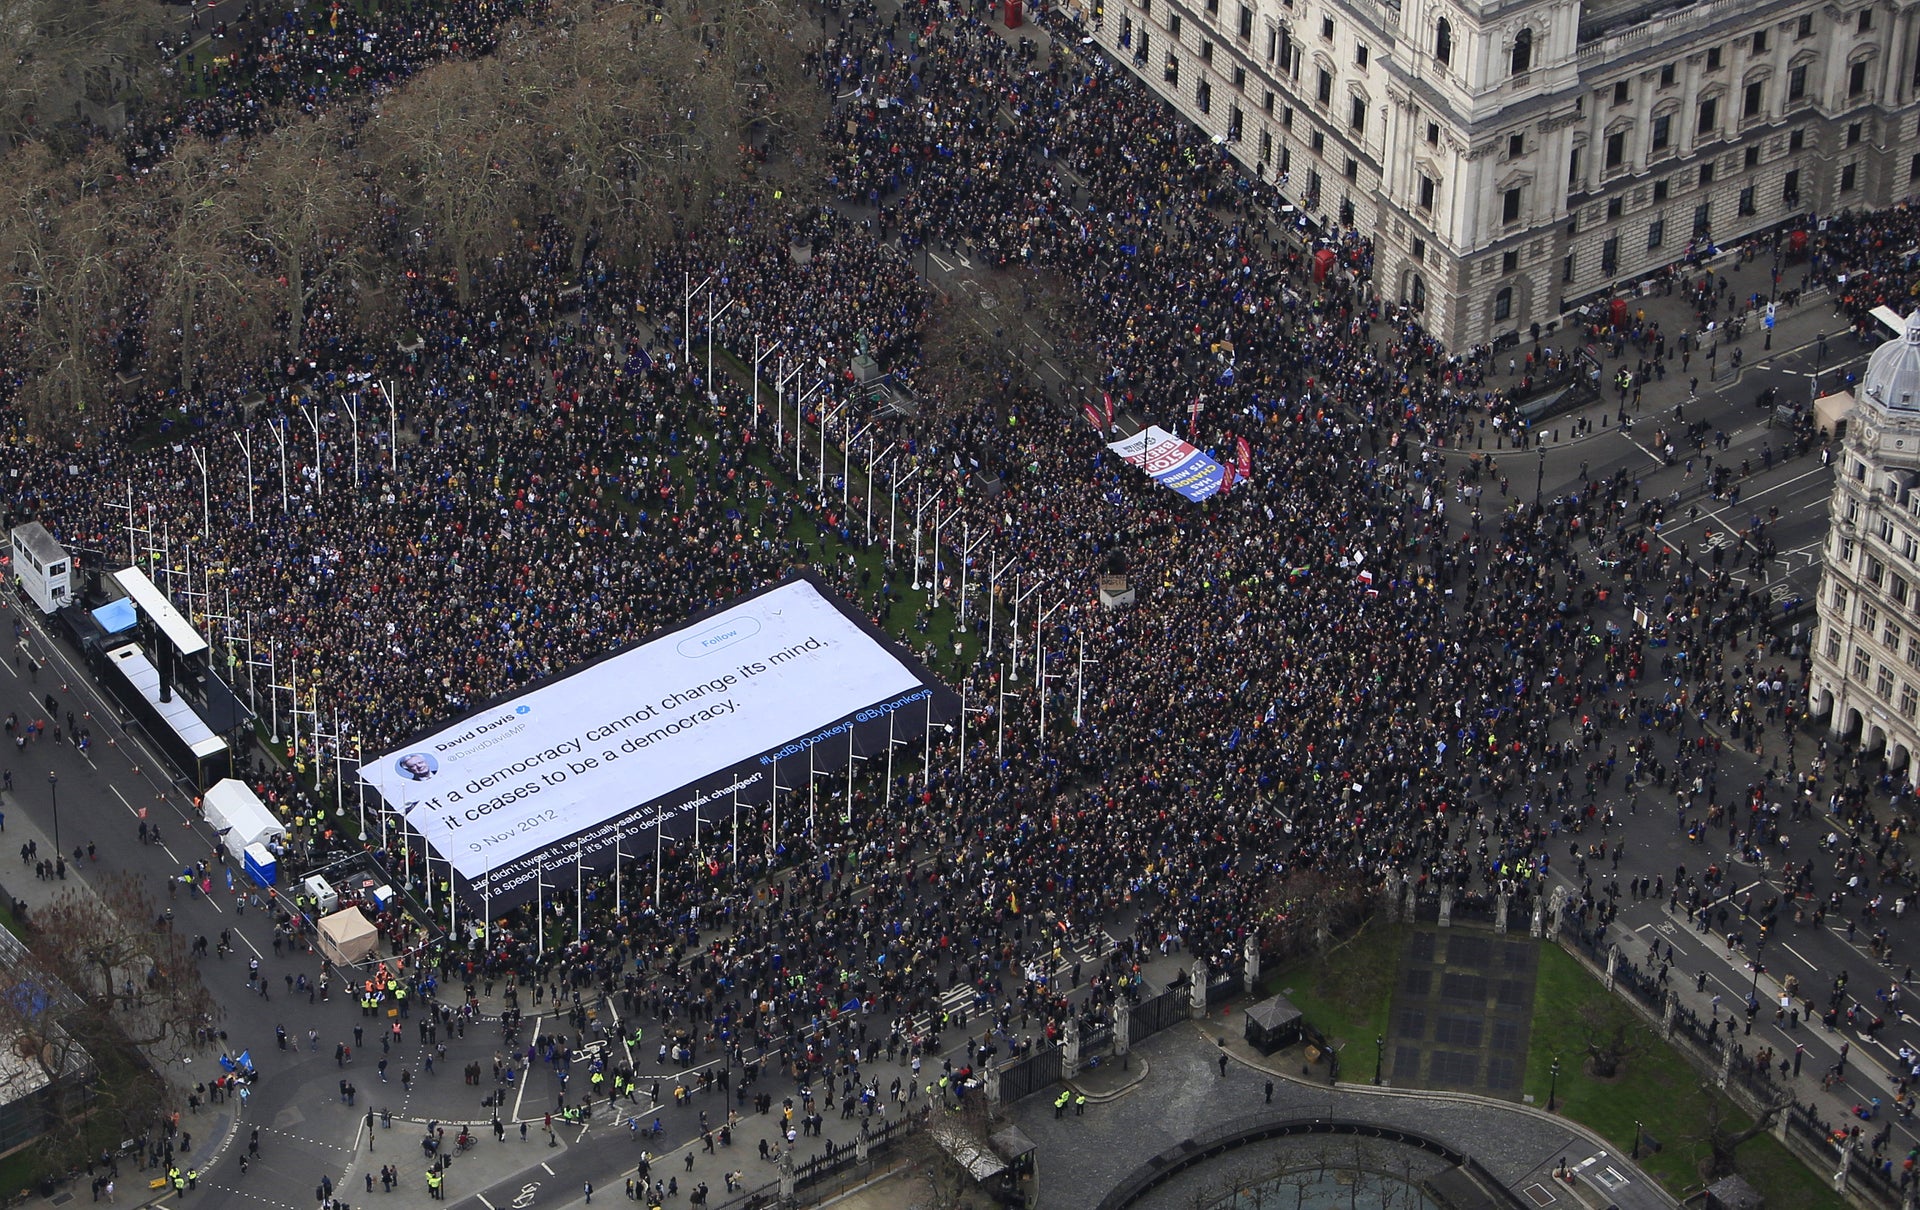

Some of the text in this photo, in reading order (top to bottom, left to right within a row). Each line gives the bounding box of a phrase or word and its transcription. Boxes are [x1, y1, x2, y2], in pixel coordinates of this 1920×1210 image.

[1131, 441, 1175, 463] BREXIT
[1147, 449, 1185, 471] STOP
[1190, 460, 1206, 472] ITS
[1163, 470, 1191, 483] MIND
[1170, 465, 1216, 488] CHANGED
[1190, 478, 1213, 490] HAS
[701, 629, 737, 648] Follow
[425, 636, 829, 811] If a democracy cannot change its mind,
[435, 713, 515, 752] David Davis
[447, 723, 526, 762] @DavidDavisMP
[759, 688, 933, 766] #LedByDonkeys @ByDonkeys
[442, 699, 741, 830] it ceases to be a democracy.
[469, 809, 559, 853] 9 Nov 2012
[471, 806, 654, 891] He didn't tweet it, he actually said it!
[480, 891, 493, 901] In
[493, 887, 503, 896] a
[502, 868, 541, 892] speech
[585, 843, 603, 854] it's
[601, 831, 627, 847] time
[625, 827, 639, 836] to
[679, 795, 711, 812] What
[711, 772, 763, 799] changed?
